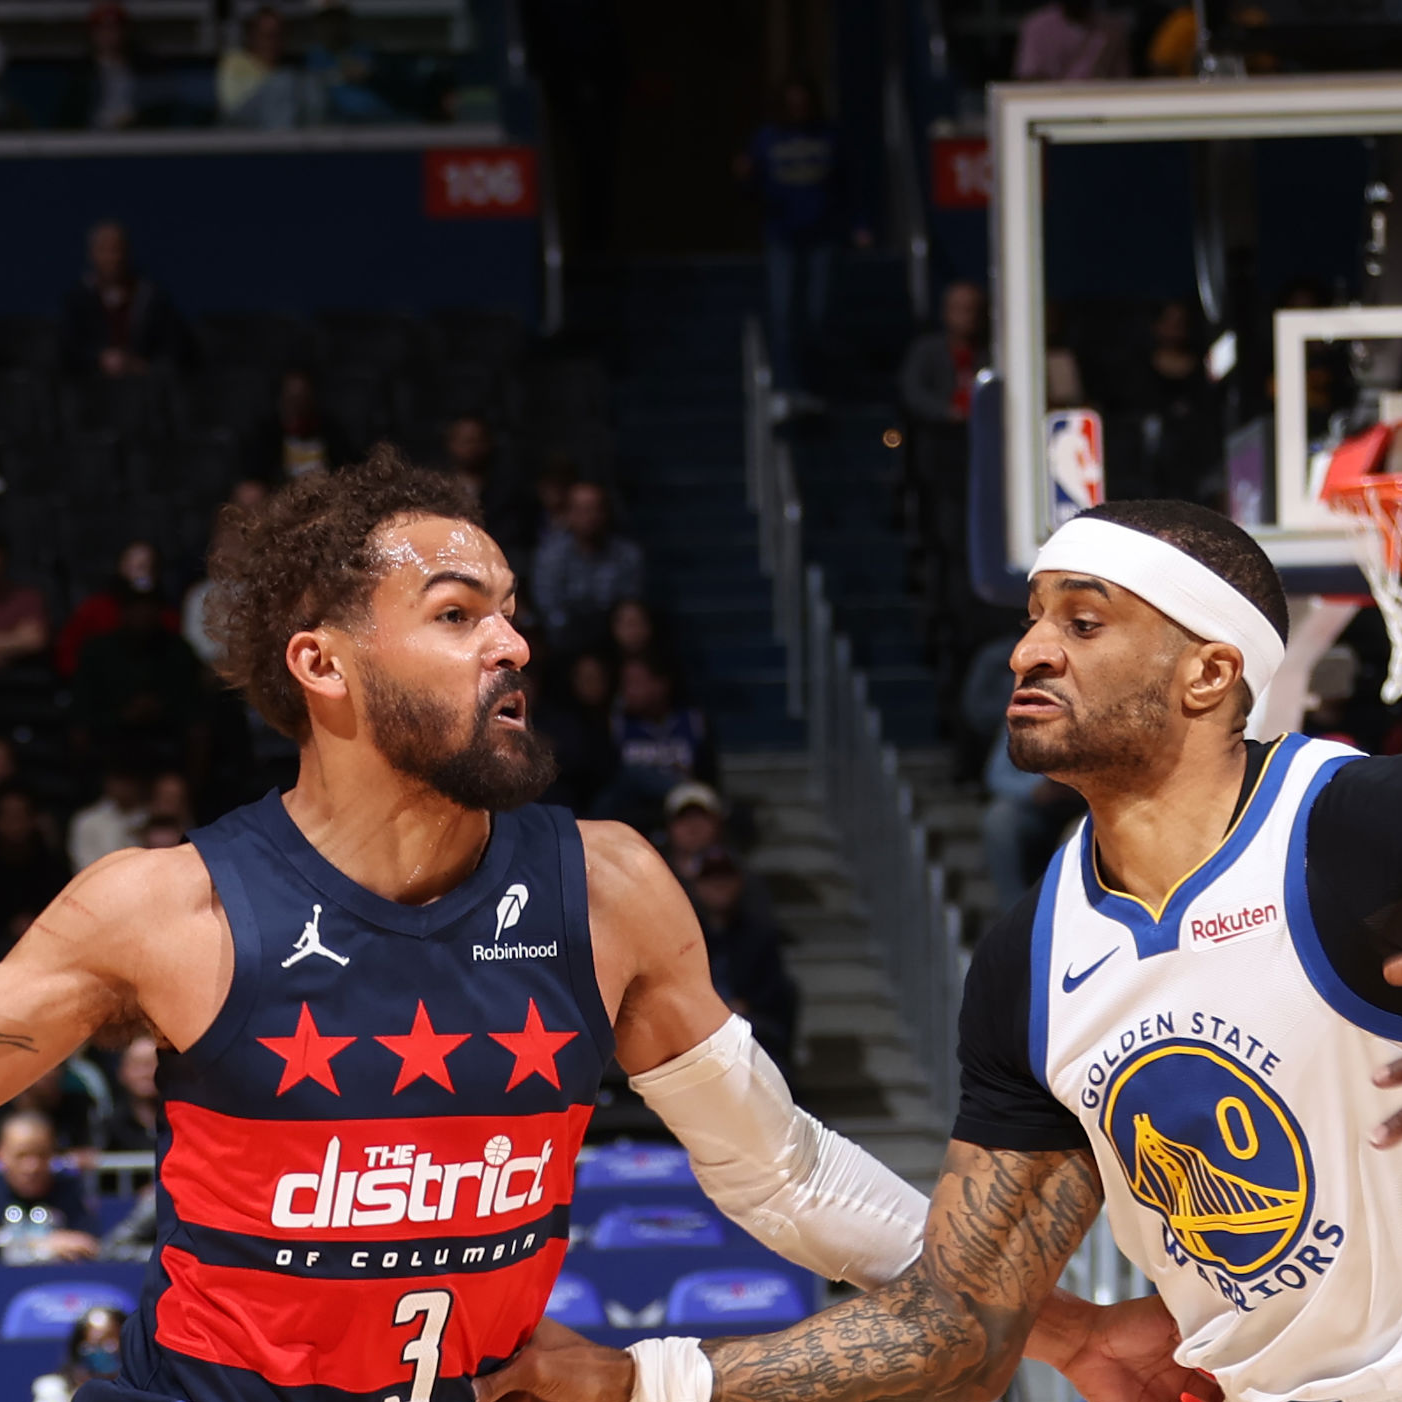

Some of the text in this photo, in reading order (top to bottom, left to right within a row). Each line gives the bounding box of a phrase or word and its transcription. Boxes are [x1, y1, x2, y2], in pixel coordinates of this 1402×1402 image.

[441, 161, 523, 208] 106
[1190, 902, 1279, 943] Rakuten
[472, 940, 559, 962] Robinhood
[1081, 1010, 1282, 1110] GOLDEN STATE
[1215, 1095, 1260, 1161] 0
[363, 1144, 417, 1169] THE
[270, 1135, 553, 1230] district
[275, 1232, 536, 1269] OF COLUMBIA
